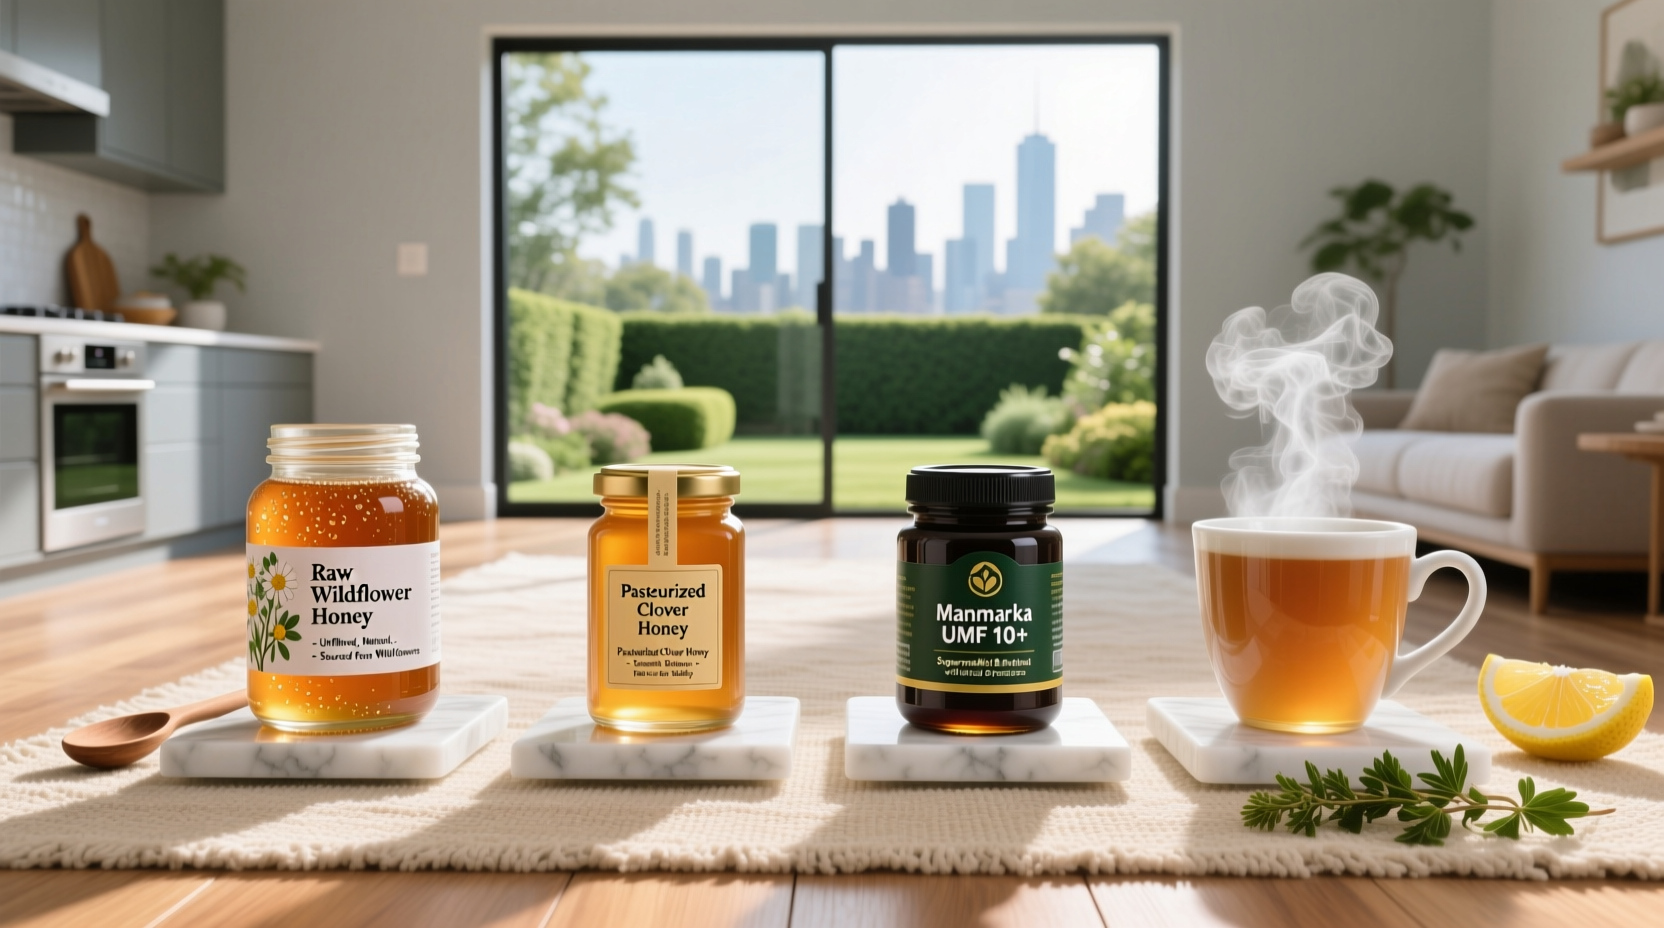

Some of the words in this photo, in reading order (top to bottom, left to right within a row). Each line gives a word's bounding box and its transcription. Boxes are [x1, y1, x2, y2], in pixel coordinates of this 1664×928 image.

[310, 563, 354, 581] Raw
[310, 584, 412, 603] Wildflower
[311, 607, 374, 629] Honey
[637, 601, 689, 617] Clover
[936, 603, 1032, 622] Manmarka
[638, 620, 689, 640] Honey
[942, 625, 988, 644] UMF
[993, 626, 1028, 645] 10+
